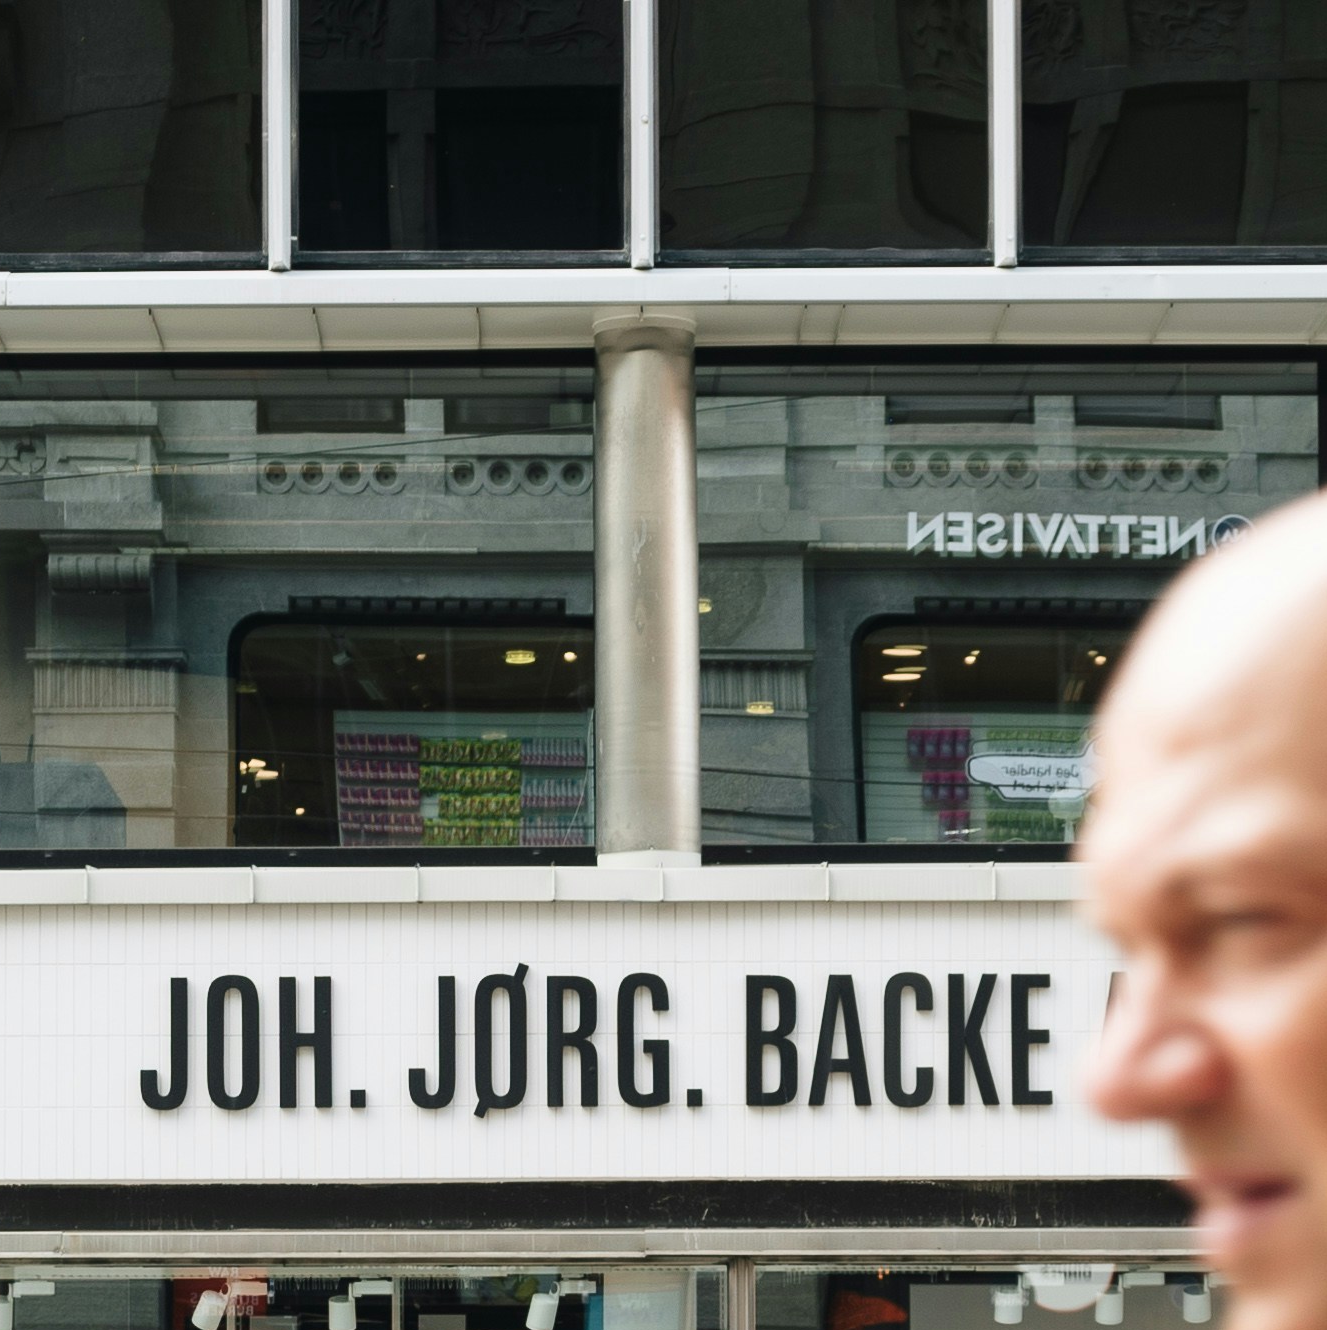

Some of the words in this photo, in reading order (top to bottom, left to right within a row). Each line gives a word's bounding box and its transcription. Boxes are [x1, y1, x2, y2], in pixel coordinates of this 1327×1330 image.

[140, 975, 366, 1110] JOH.
[408, 963, 702, 1118] JØRG.
[745, 972, 1052, 1108] BACKE
